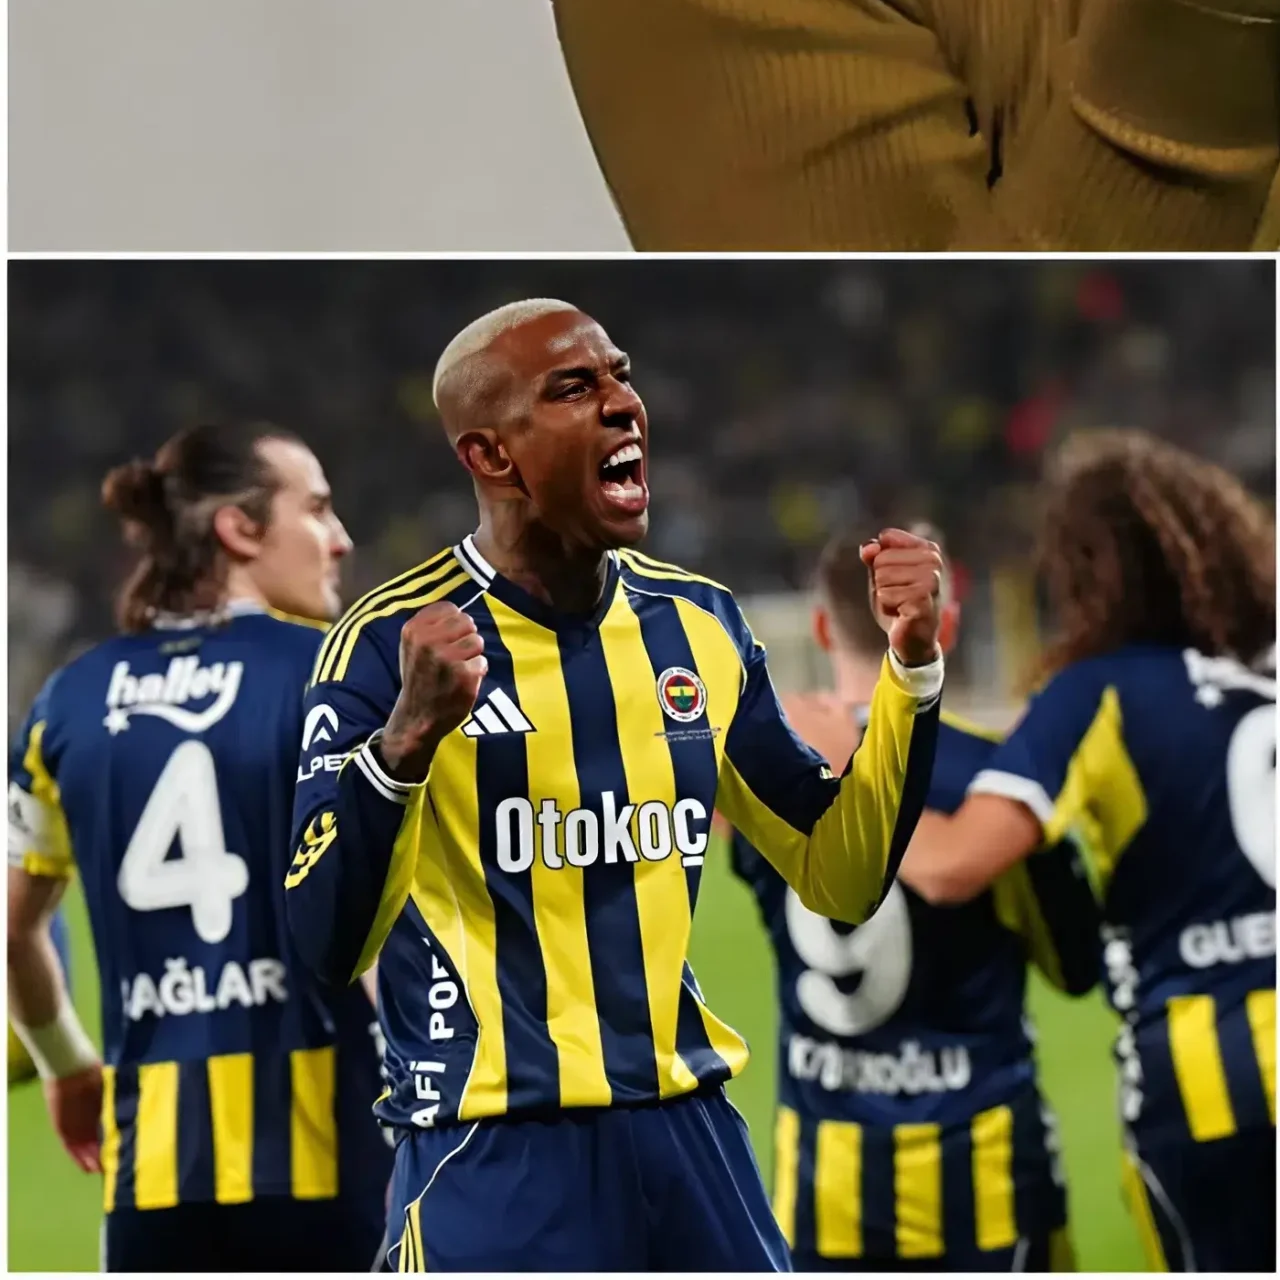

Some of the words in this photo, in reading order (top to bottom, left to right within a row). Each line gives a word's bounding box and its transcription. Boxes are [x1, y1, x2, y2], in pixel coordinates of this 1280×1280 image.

[117, 739, 249, 944] 4
[495, 790, 708, 873] Otokoç
[121, 956, 288, 1022] AĞLAR
[785, 878, 914, 1037] 9
